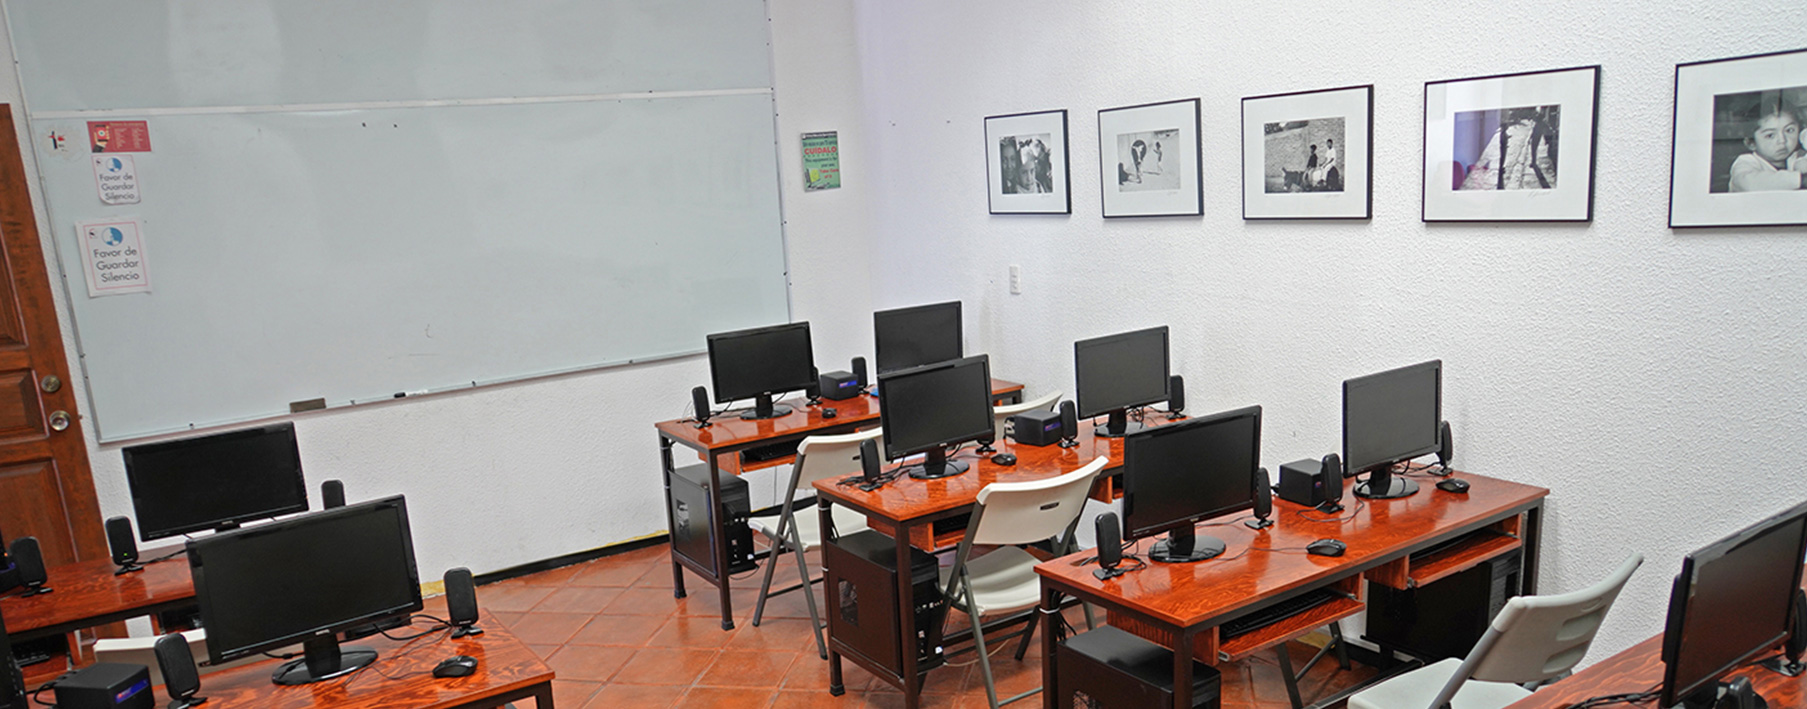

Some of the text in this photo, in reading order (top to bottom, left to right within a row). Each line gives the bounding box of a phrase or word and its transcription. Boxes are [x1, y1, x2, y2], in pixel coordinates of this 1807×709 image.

[99, 172, 133, 182] Favor de
[101, 182, 134, 191] Guardar
[105, 192, 135, 201] Silencio
[93, 246, 137, 258] Favor de
[96, 258, 139, 271] Guardar
[100, 271, 140, 283] Silencio
